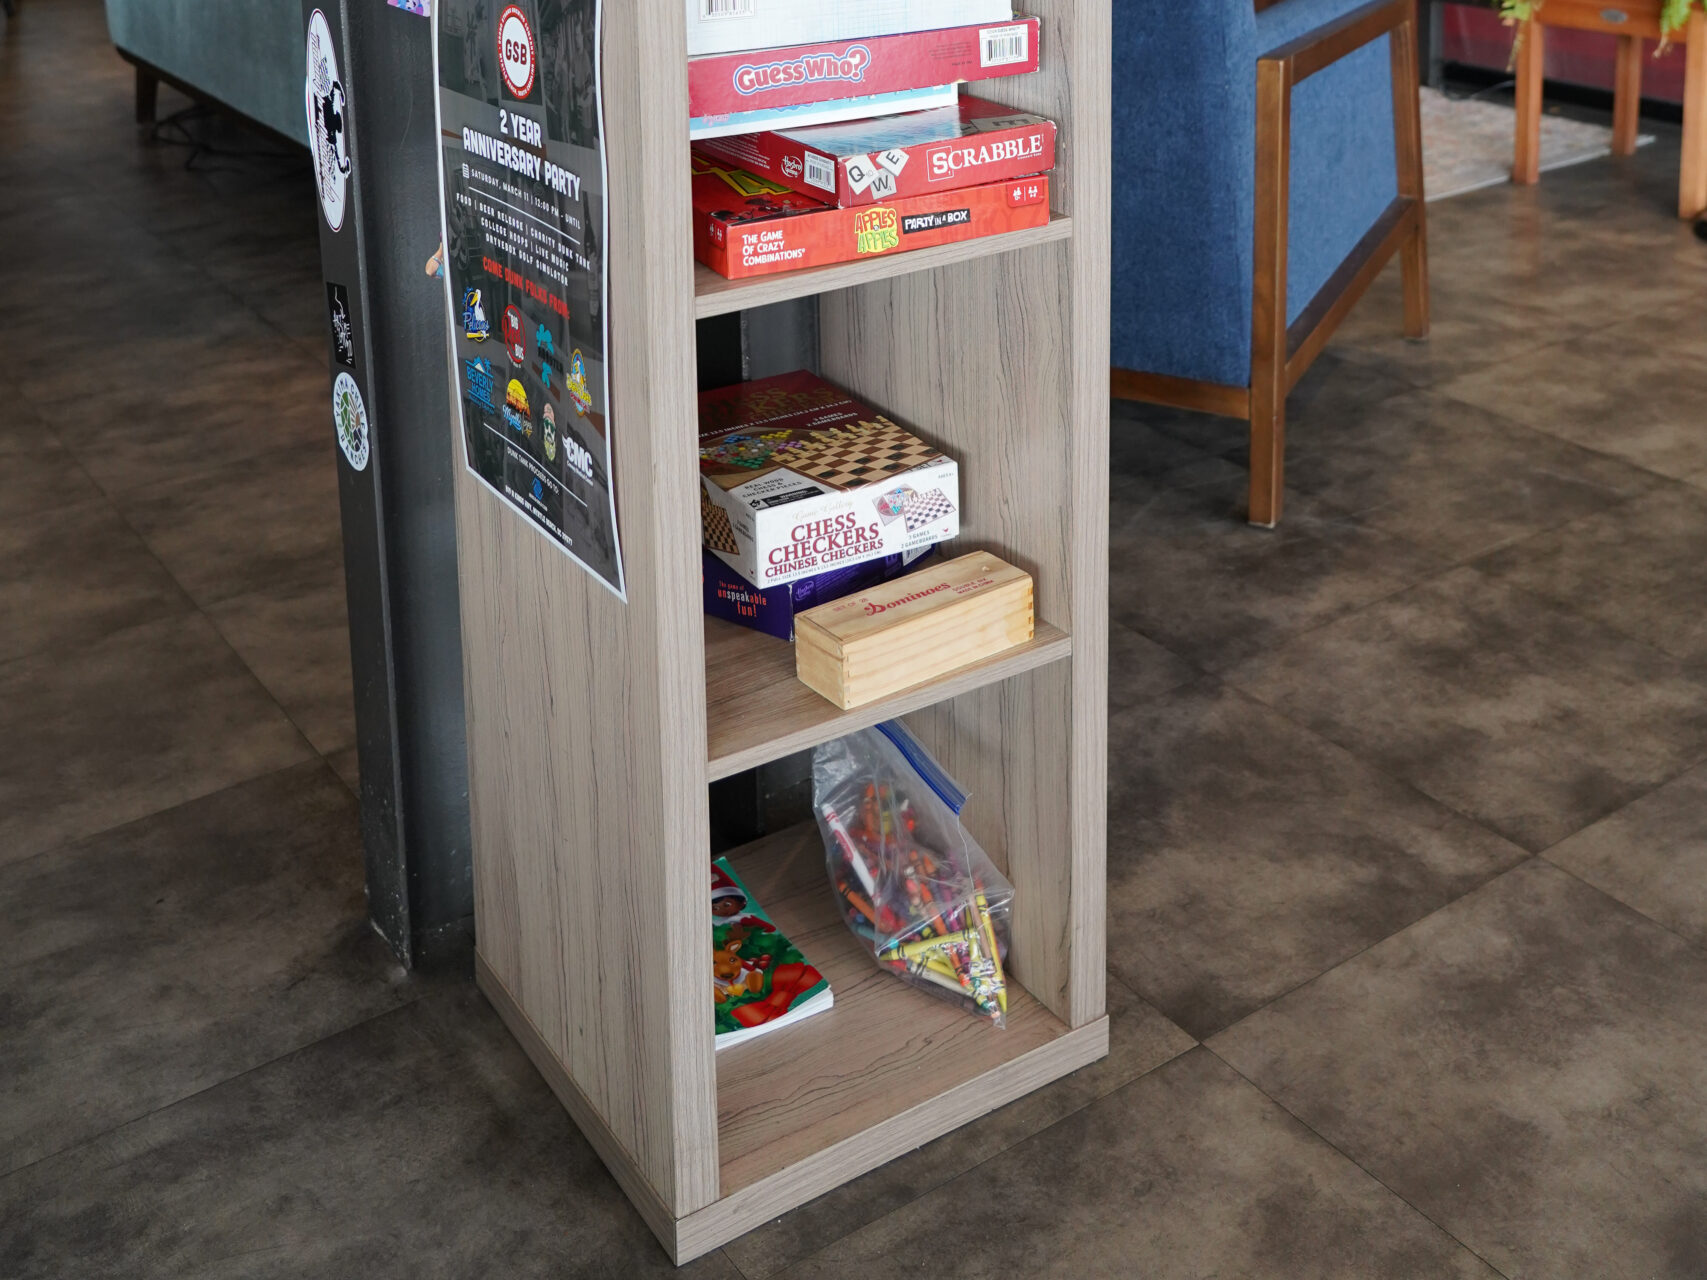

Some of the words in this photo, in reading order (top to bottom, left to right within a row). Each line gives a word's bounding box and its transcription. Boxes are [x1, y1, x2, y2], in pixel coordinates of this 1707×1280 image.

[505, 38, 527, 66] GSB
[737, 63, 804, 92] Guess
[804, 49, 867, 79] Who?
[499, 108, 508, 135] 2
[510, 111, 542, 148] YEAR
[463, 126, 541, 182] ANNIVERSARY
[544, 159, 581, 202] PARTY
[885, 151, 900, 166] E
[932, 133, 1043, 175] SCRABBLE
[848, 164, 866, 183] Q
[872, 174, 889, 192] W
[471, 167, 501, 192] SATURDAY,
[502, 180, 523, 200] MARCH
[535, 197, 550, 213] 12:00
[551, 205, 559, 217] PM
[565, 213, 581, 229] UNTIL
[456, 192, 472, 207] FOOD
[479, 202, 495, 217] BEER
[497, 210, 524, 231] RELEASE
[530, 227, 556, 249] CHARITY
[576, 253, 591, 270] TANK
[855, 208, 897, 234] APPLES
[904, 215, 934, 230] PARTY
[934, 216, 942, 225] IN
[947, 210, 968, 222] BOX
[480, 216, 507, 237] COLLEGE
[509, 231, 529, 247] HOOPS
[535, 244, 549, 260] LIVE
[551, 254, 569, 272] MUSIC
[742, 233, 759, 245] THE
[760, 230, 784, 242] GAME
[742, 245, 755, 256] OF
[757, 240, 785, 254] CRAZY
[857, 229, 899, 253] APPLES
[518, 249, 534, 265] GOLF
[536, 258, 569, 286] SIMULATOR
[482, 256, 503, 279] COME
[504, 268, 524, 291] DUNK
[525, 279, 548, 305] FOLKS
[549, 292, 570, 319] FROM:
[467, 366, 494, 393] BEVERLY
[472, 383, 491, 403] HOMES
[335, 376, 349, 417] YAKIMA
[566, 436, 593, 479] CMC
[791, 512, 856, 543] CHESS
[904, 534, 938, 548] GAMEBOARDS
[912, 530, 930, 538] GAMES
[768, 522, 880, 565] CHECKERS
[765, 556, 818, 579] CHINESE
[821, 538, 884, 565] CHECKERS
[717, 588, 767, 606] unspeakable
[863, 581, 951, 617] Dominoes
[952, 581, 976, 592] DOUBLE
[737, 601, 757, 617] fun!
[832, 605, 846, 613] SET
